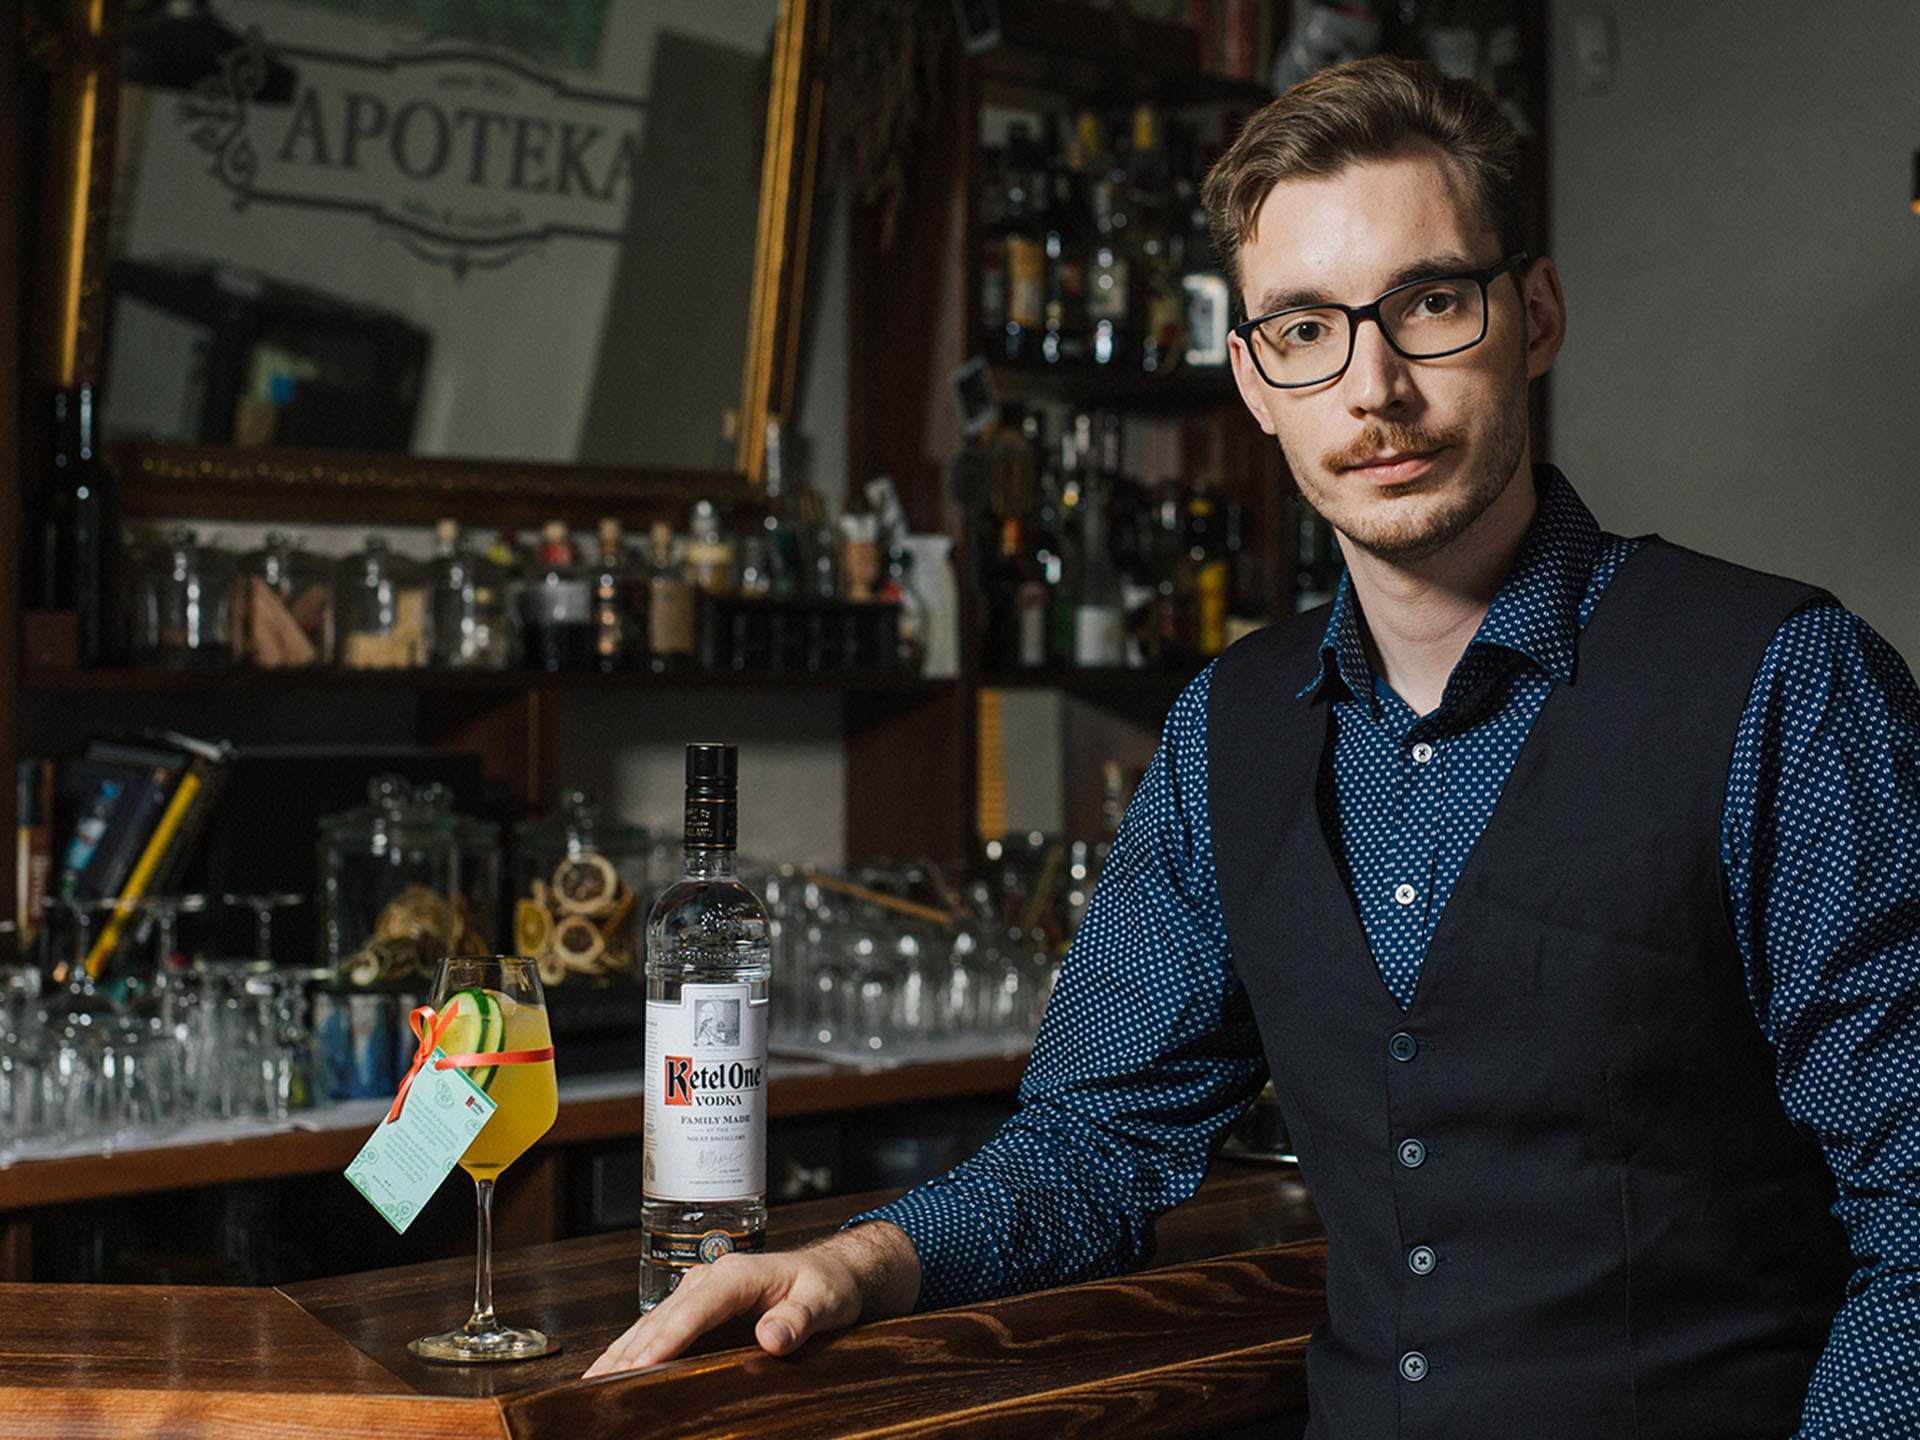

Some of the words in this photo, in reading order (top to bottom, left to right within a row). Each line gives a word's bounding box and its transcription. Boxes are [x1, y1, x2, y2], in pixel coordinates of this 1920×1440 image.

[668, 1061, 726, 1102] Ketel
[728, 1062, 761, 1089] One
[695, 1095, 742, 1106] VODKA
